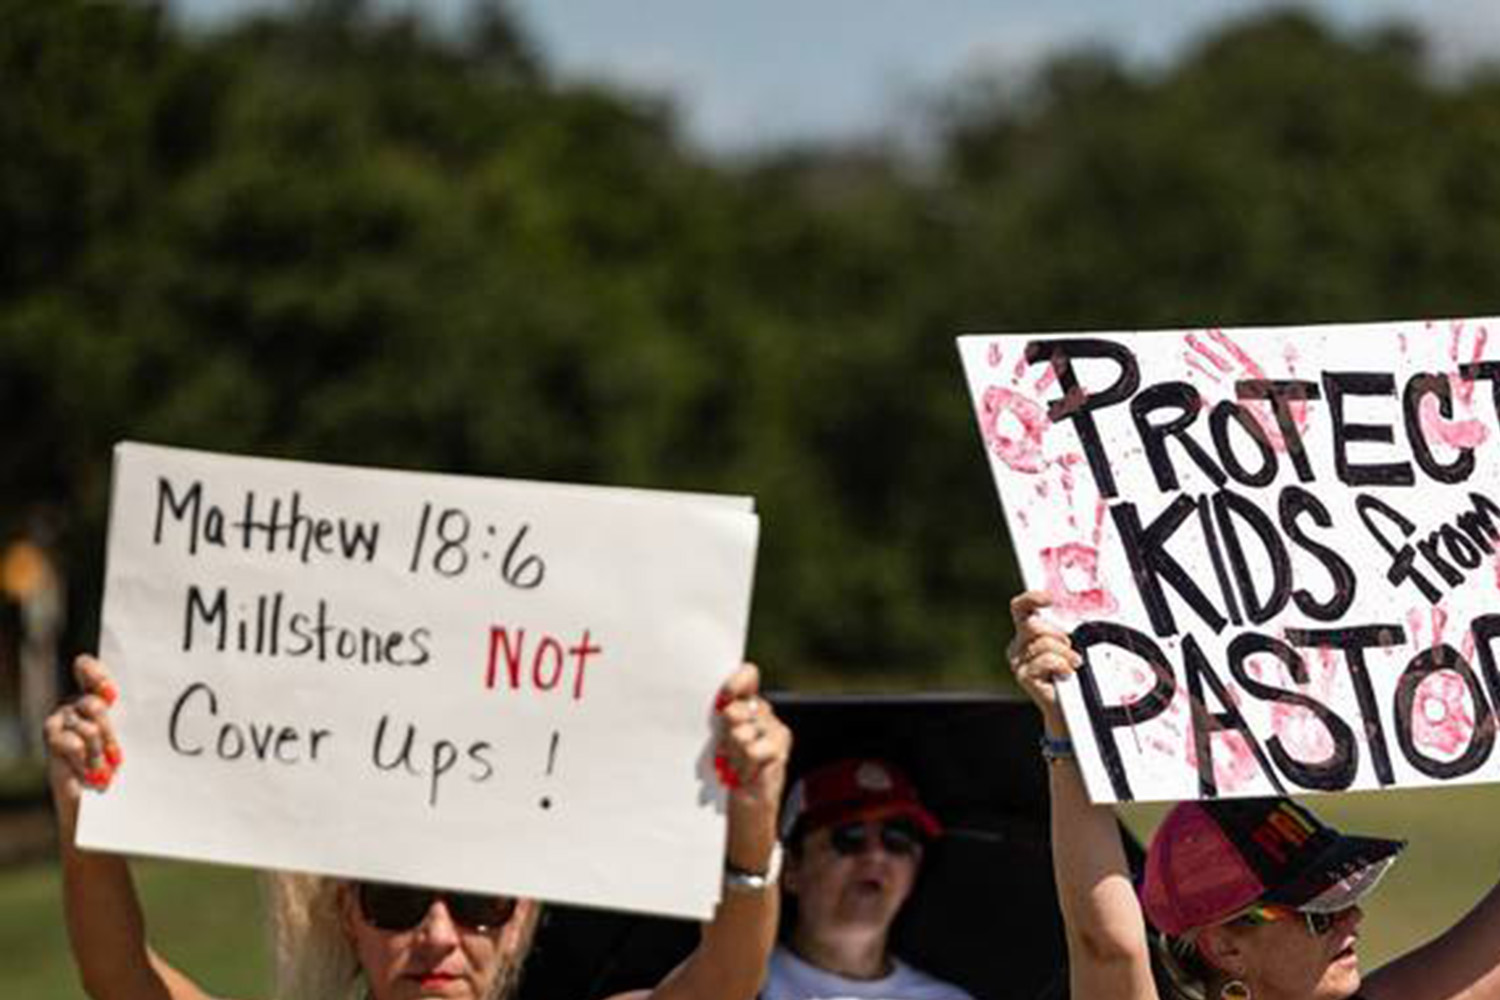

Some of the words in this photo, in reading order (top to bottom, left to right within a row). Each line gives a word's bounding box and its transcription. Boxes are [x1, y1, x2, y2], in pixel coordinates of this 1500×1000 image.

[152, 476, 380, 563] Matthew
[408, 502, 546, 589] 18:6
[1110, 485, 1357, 637] KIDS
[182, 586, 431, 666] Millstones
[168, 681, 332, 764] Cover
[372, 715, 494, 805] Ups
